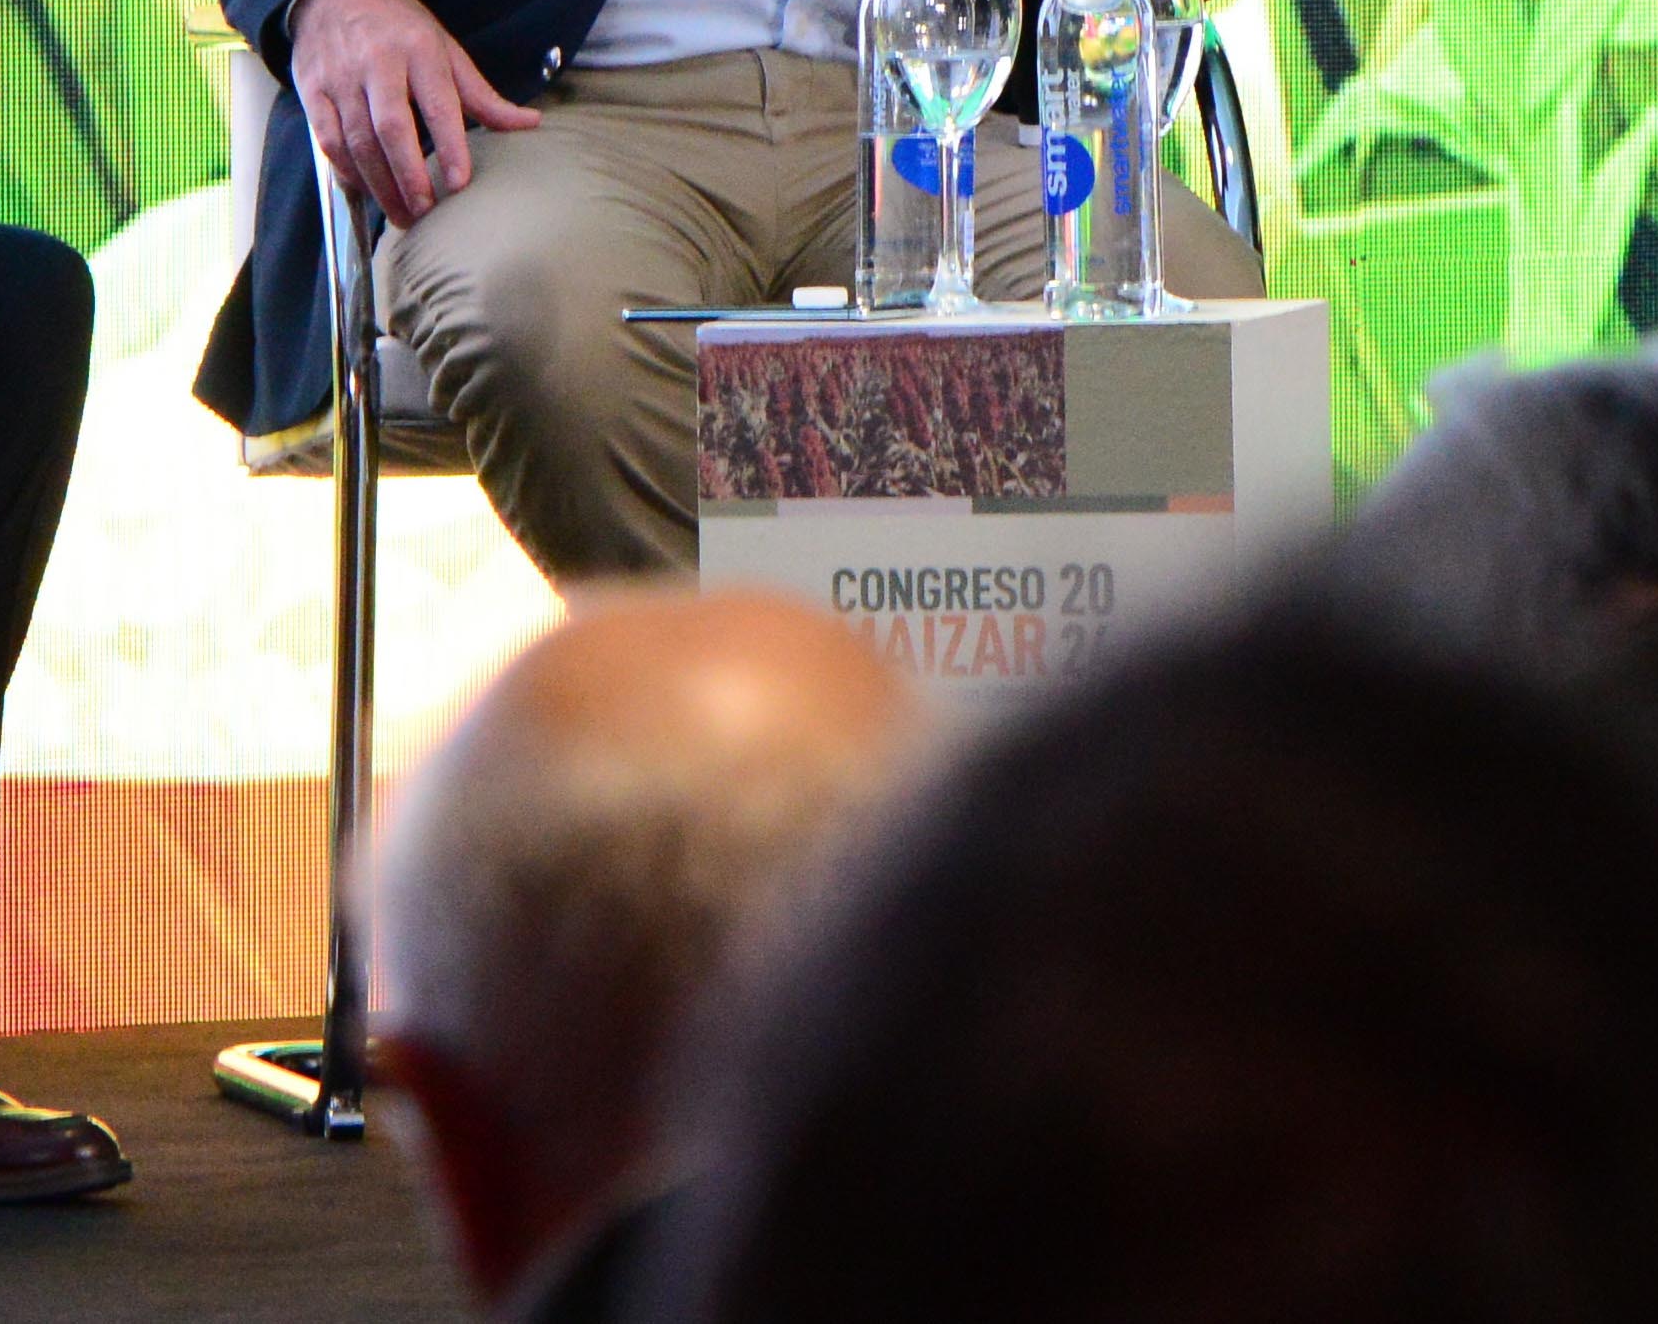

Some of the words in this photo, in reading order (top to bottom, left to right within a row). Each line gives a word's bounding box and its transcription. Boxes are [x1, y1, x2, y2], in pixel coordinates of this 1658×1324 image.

[1041, 67, 1068, 199] smart
[832, 566, 1045, 612] CONGRESO
[1059, 562, 1114, 617] 20
